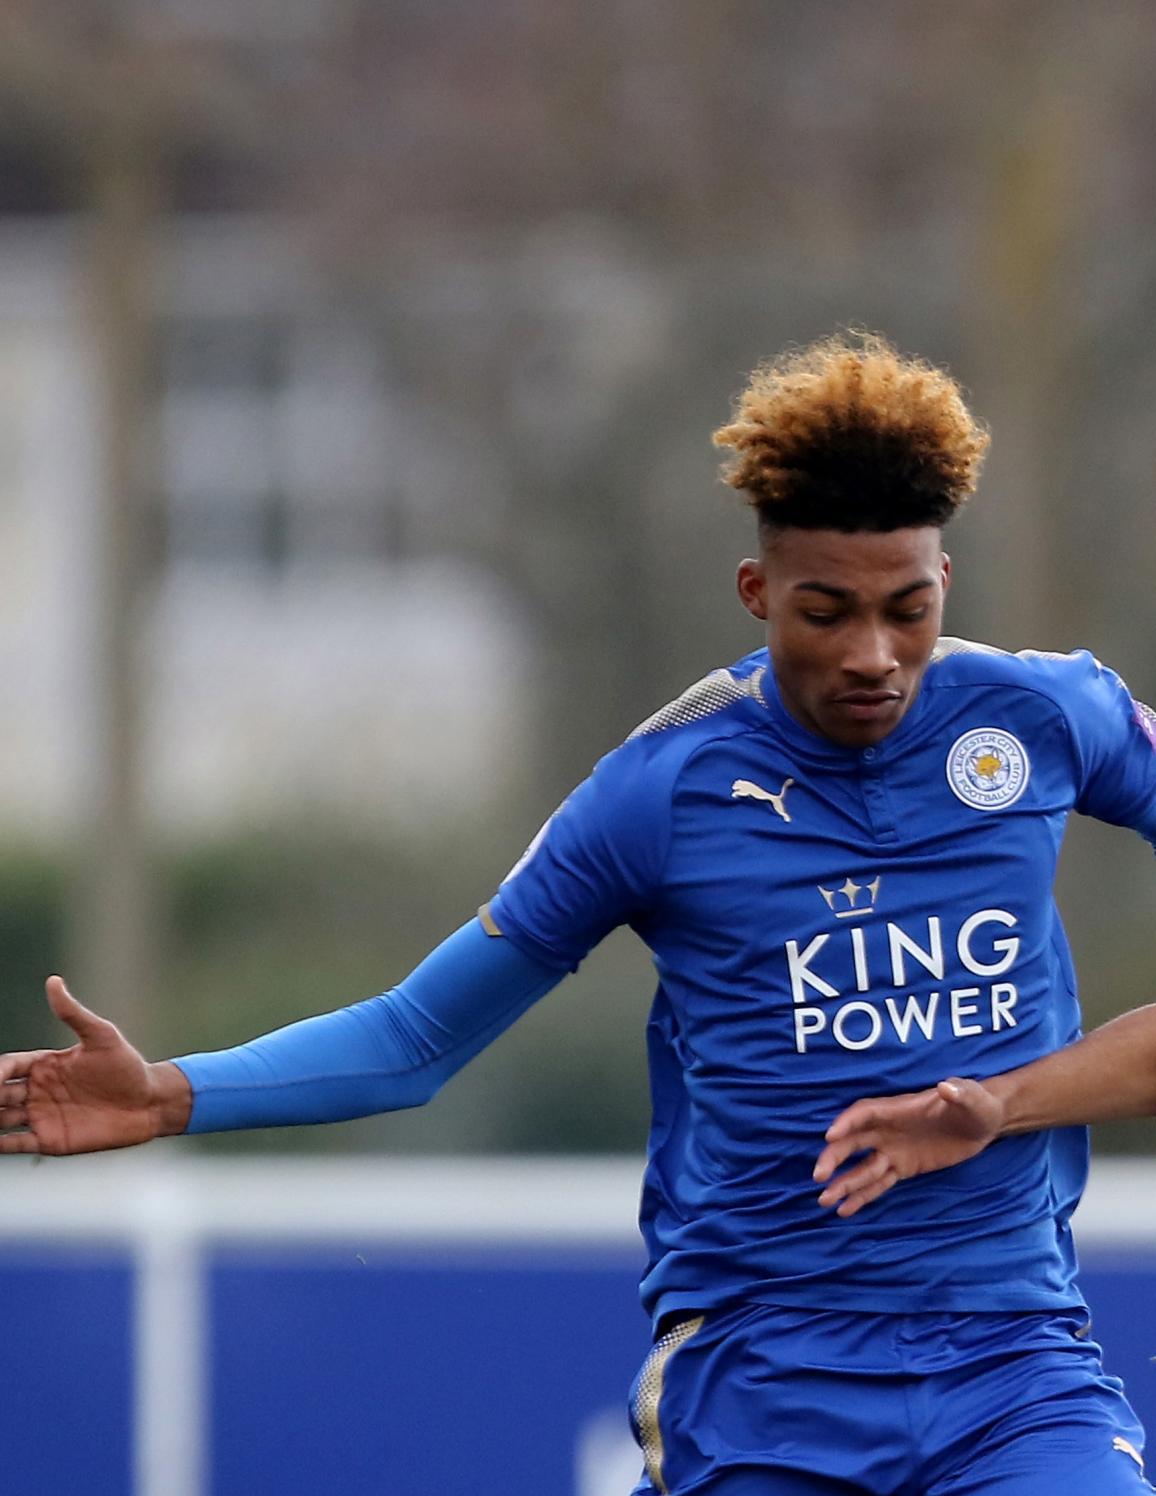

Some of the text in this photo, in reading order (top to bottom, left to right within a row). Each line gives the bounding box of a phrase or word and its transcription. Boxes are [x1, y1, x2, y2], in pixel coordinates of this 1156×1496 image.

[997, 738, 1018, 757] CITY
[785, 909, 1021, 1003] KING
[793, 983, 1018, 1053] POWER
